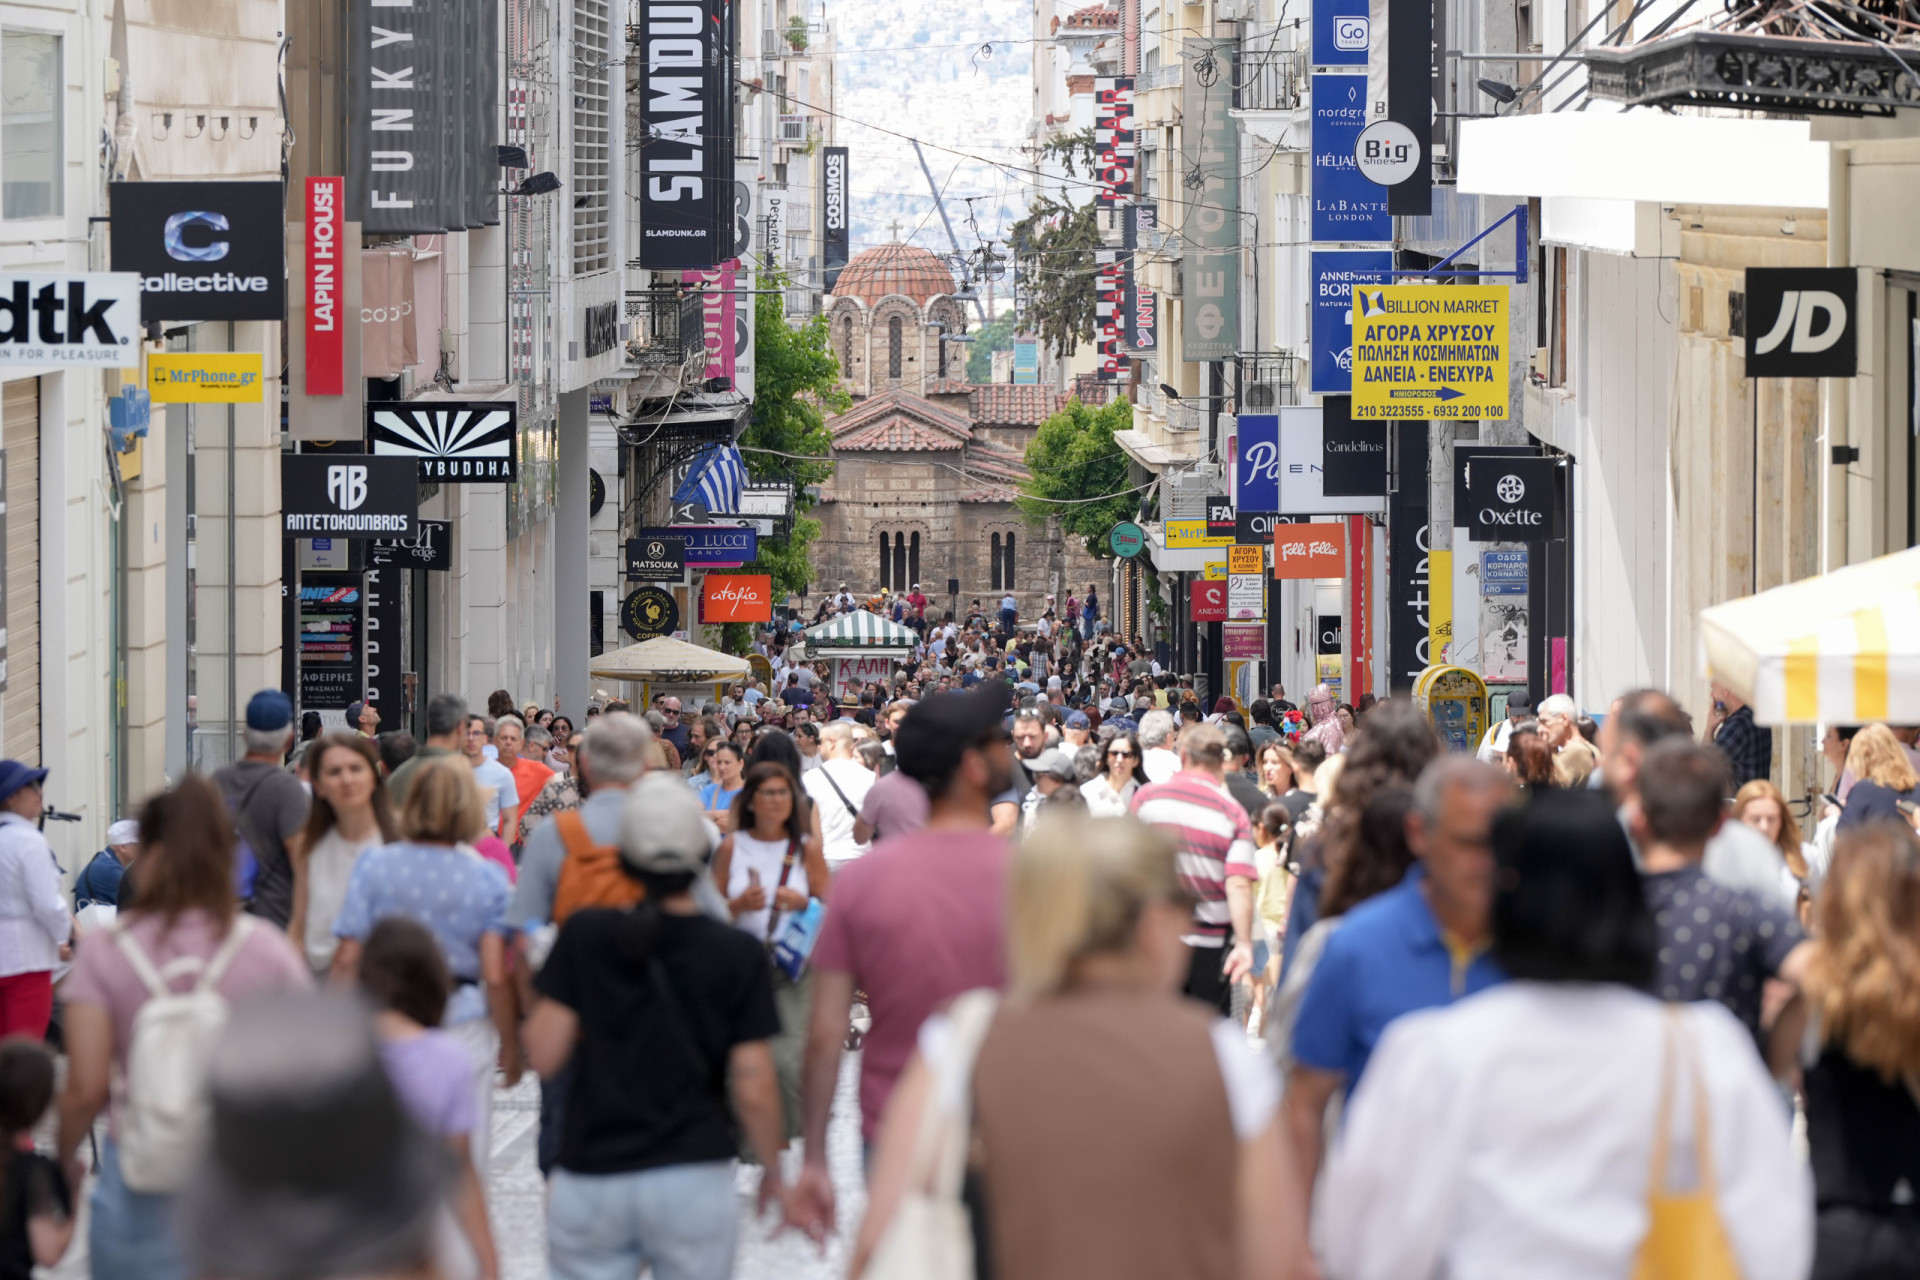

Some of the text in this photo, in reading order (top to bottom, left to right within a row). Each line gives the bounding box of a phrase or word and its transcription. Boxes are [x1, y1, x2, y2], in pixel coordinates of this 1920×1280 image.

[1340, 23, 1364, 39] Go
[1102, 86, 1128, 200] POP-AIR
[1365, 140, 1408, 163] Big
[1363, 156, 1396, 166] shoes
[827, 154, 840, 230] COSMOS
[645, 229, 706, 238] SLAMDUNK.GR
[314, 182, 334, 331] LAPIN HOUSE
[141, 273, 268, 292] ollective
[1386, 300, 1500, 314] BILLION MARKET
[1755, 291, 1847, 354] JD
[1364, 324, 1496, 342] ΑΓΟΡΑ ΧΡΥΣΟΥ
[19, 348, 44, 359] FOR
[52, 349, 119, 361] PLEASURE
[1357, 345, 1499, 362] ΠΩΛΗΣΗ ΚΟΣΜΗΜΑΤΩΝ
[169, 368, 257, 386] MrPhone.gr
[1363, 366, 1417, 383] ΔΑΝΕΙΑ
[1428, 366, 1494, 383] ΕΝΕΧΥΡΑ
[1393, 389, 1438, 398] ΗΜΙΟΡΟΦΟΣ
[1357, 405, 1377, 417] 210
[1379, 405, 1424, 417] 3223555
[1433, 405, 1459, 417] 6932
[1461, 405, 1481, 417] 200
[1484, 405, 1504, 417] 100
[1326, 440, 1384, 453] Candelinas
[418, 461, 510, 476] YBUDDHA
[286, 513, 408, 532] ANTETOKOUNBROS
[1479, 507, 1543, 526] Oxétte
[704, 534, 748, 547] LUCCI
[411, 546, 437, 562] edge
[1232, 555, 1259, 563] ΧΡΥΣΟΥ
[1234, 547, 1257, 555] ΑΓΟΡΑ
[1282, 541, 1338, 562] Folli Follie
[632, 560, 679, 569] MATSOUKA
[302, 672, 353, 682] ΑΦΕΙΡΗΣ
